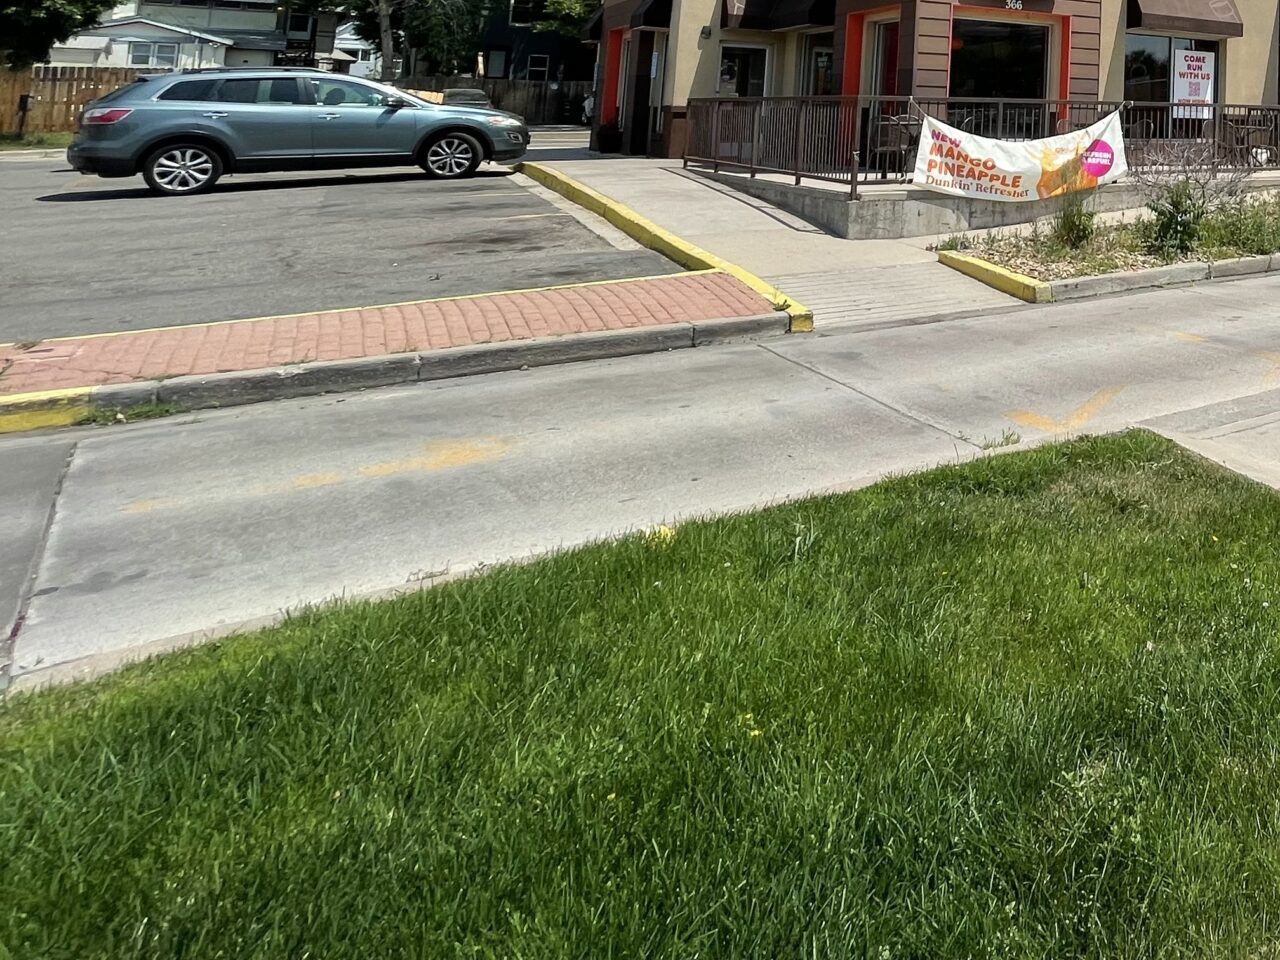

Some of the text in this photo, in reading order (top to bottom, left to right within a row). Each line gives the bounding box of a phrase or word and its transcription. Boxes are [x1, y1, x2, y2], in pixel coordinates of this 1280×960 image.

[1005, 0, 1023, 10] 366
[1184, 55, 1207, 63] COME
[1179, 72, 1199, 80] WITH
[931, 129, 962, 148] NEW
[929, 143, 996, 171] MANGO
[927, 159, 1022, 189] PINEAPPLE
[926, 175, 1030, 199] Dunkin' Refresher
